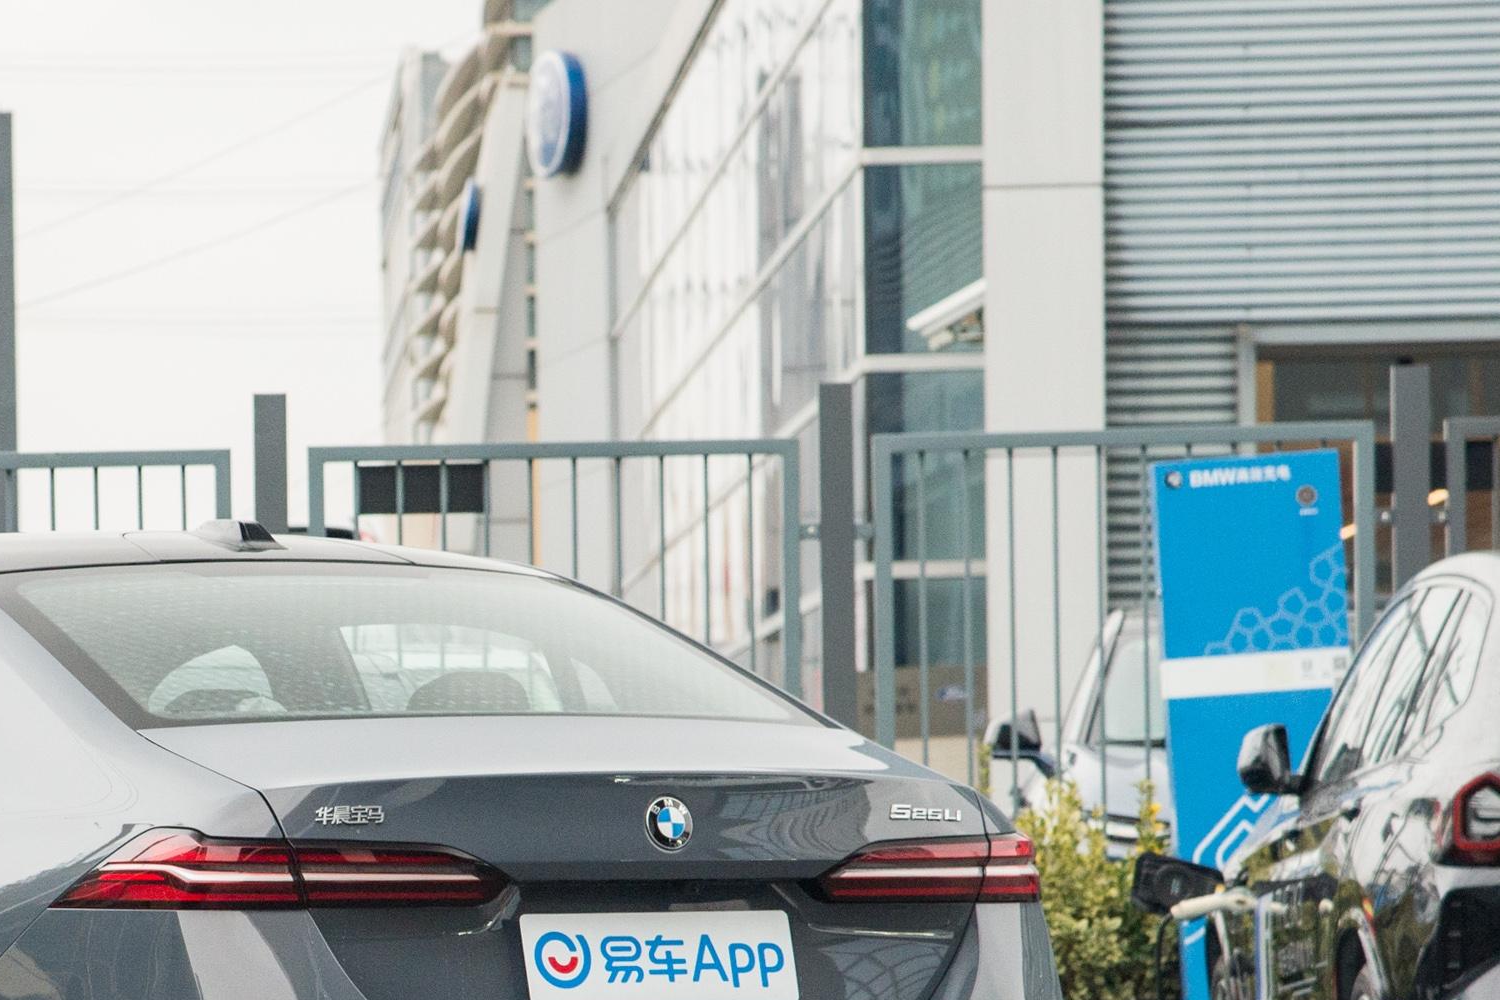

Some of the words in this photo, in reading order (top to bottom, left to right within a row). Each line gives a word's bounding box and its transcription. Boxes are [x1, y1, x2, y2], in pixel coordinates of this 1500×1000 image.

[1189, 466, 1236, 488] BMW
[315, 805, 385, 825] 华晨宝马
[600, 934, 785, 988] 易车App
